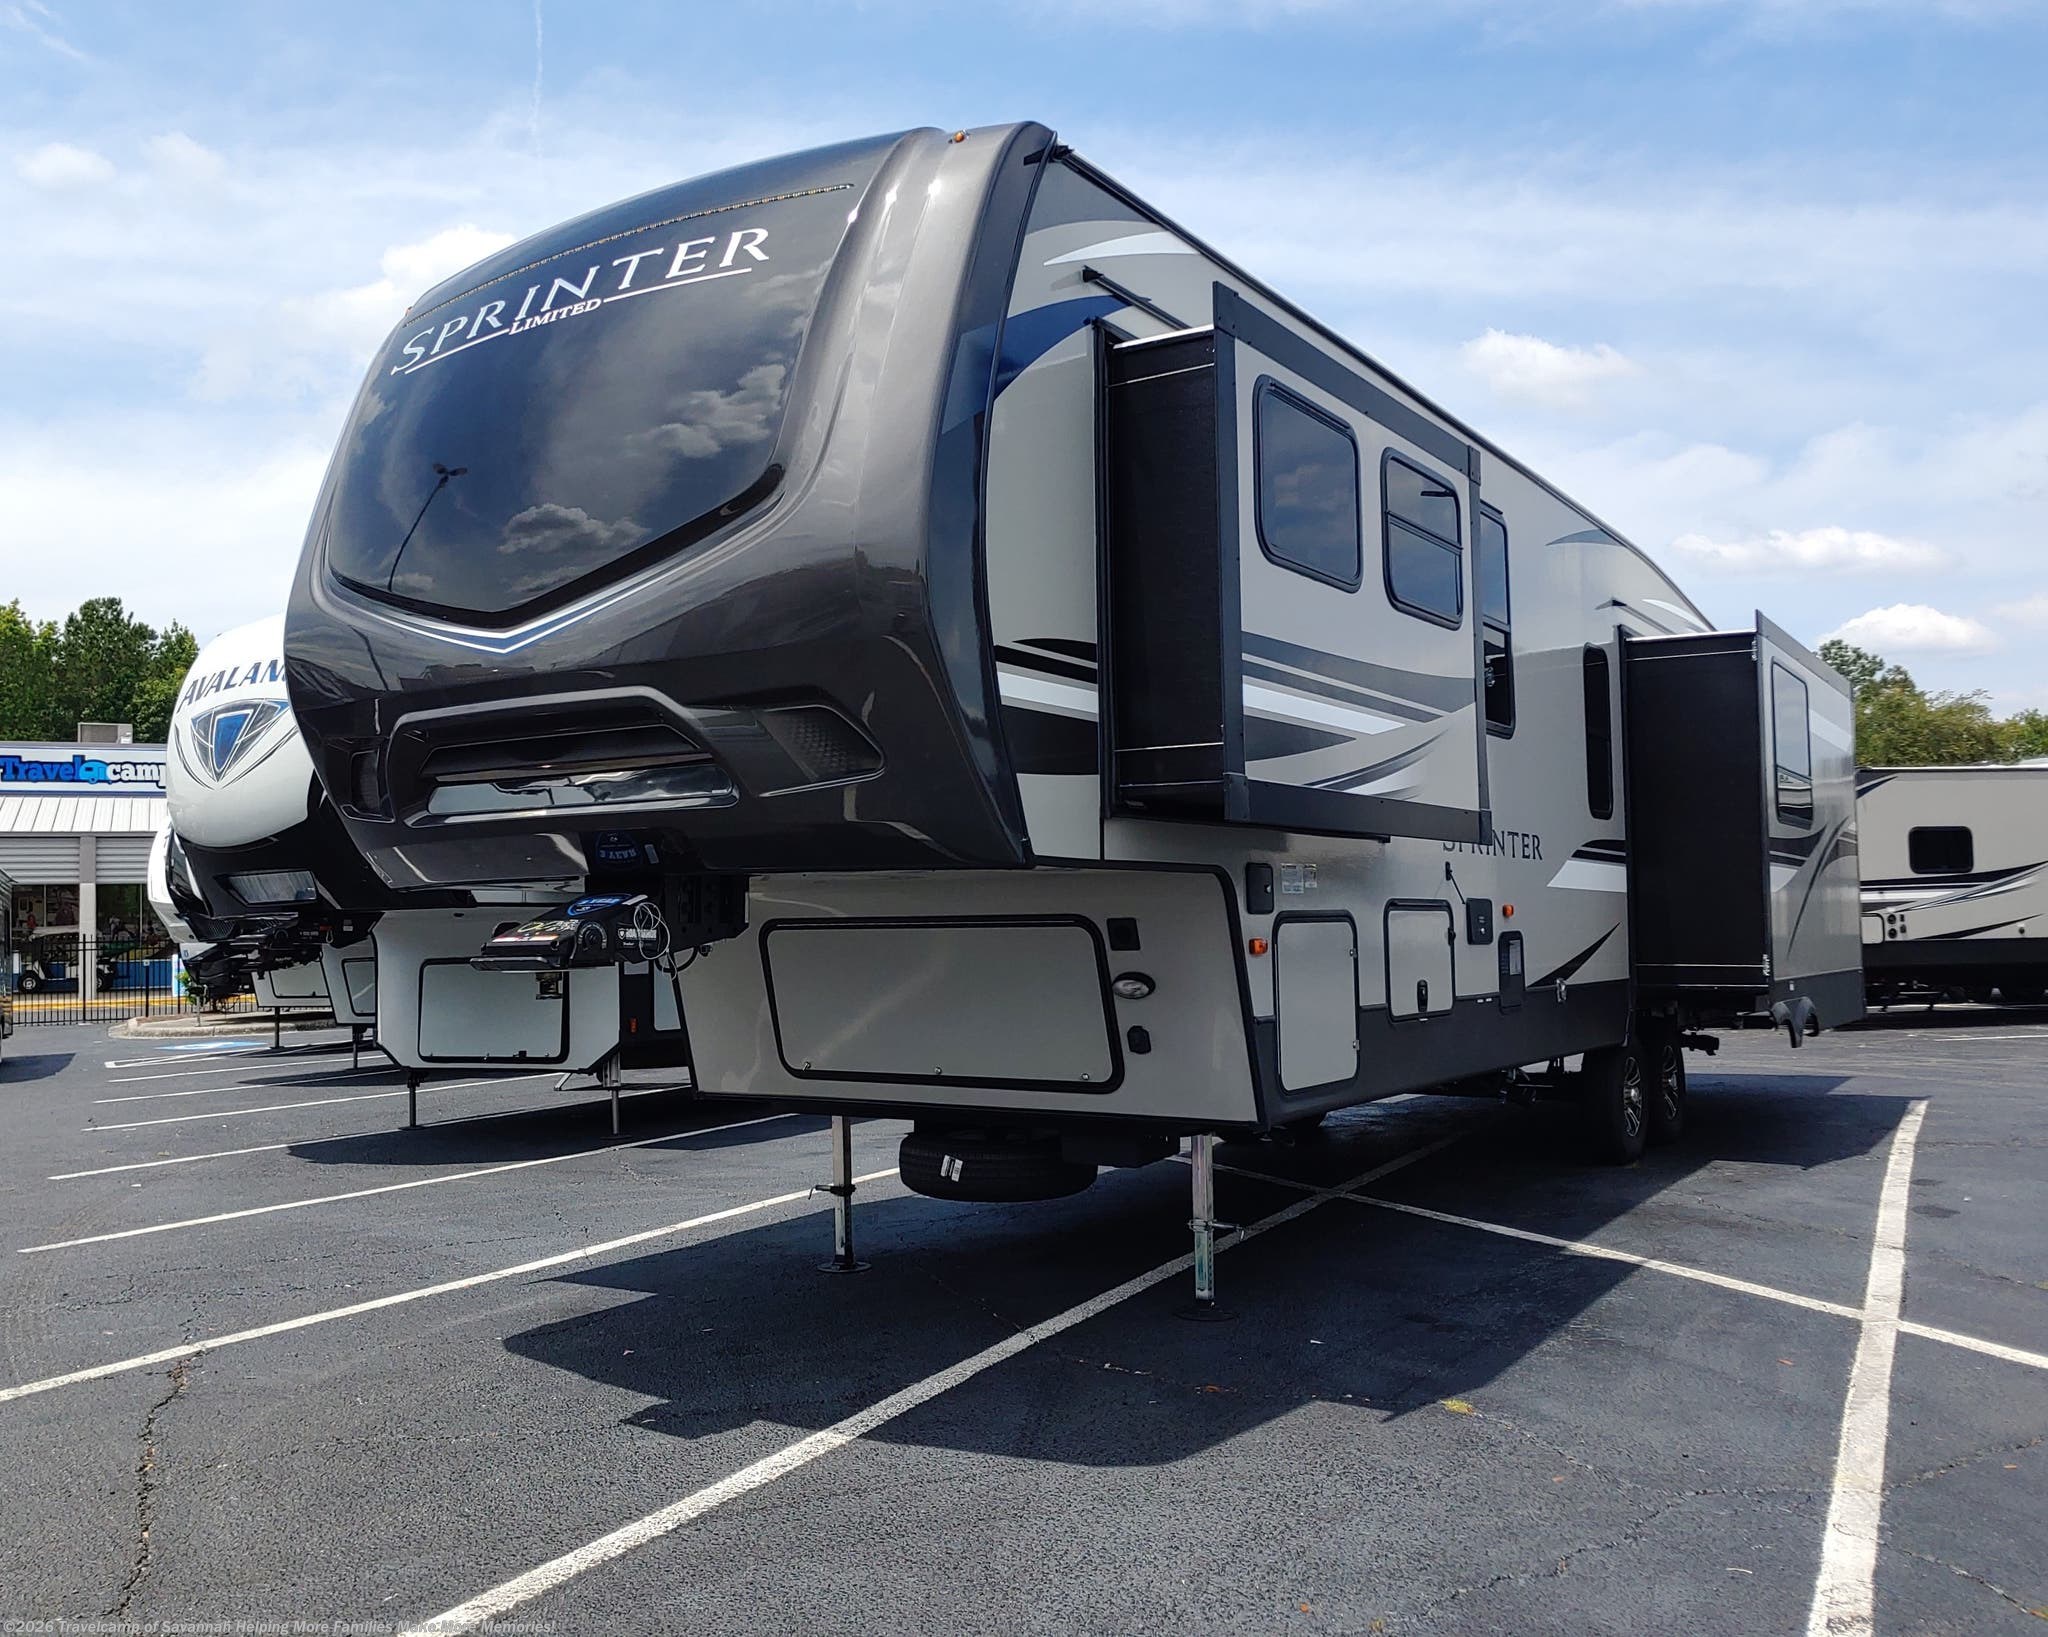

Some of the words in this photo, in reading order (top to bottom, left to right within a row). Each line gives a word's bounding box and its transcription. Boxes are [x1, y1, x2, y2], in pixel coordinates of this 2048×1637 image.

[391, 228, 770, 376] SPRINTER
[509, 299, 602, 335] LIMITED
[176, 659, 287, 713] AVALAN
